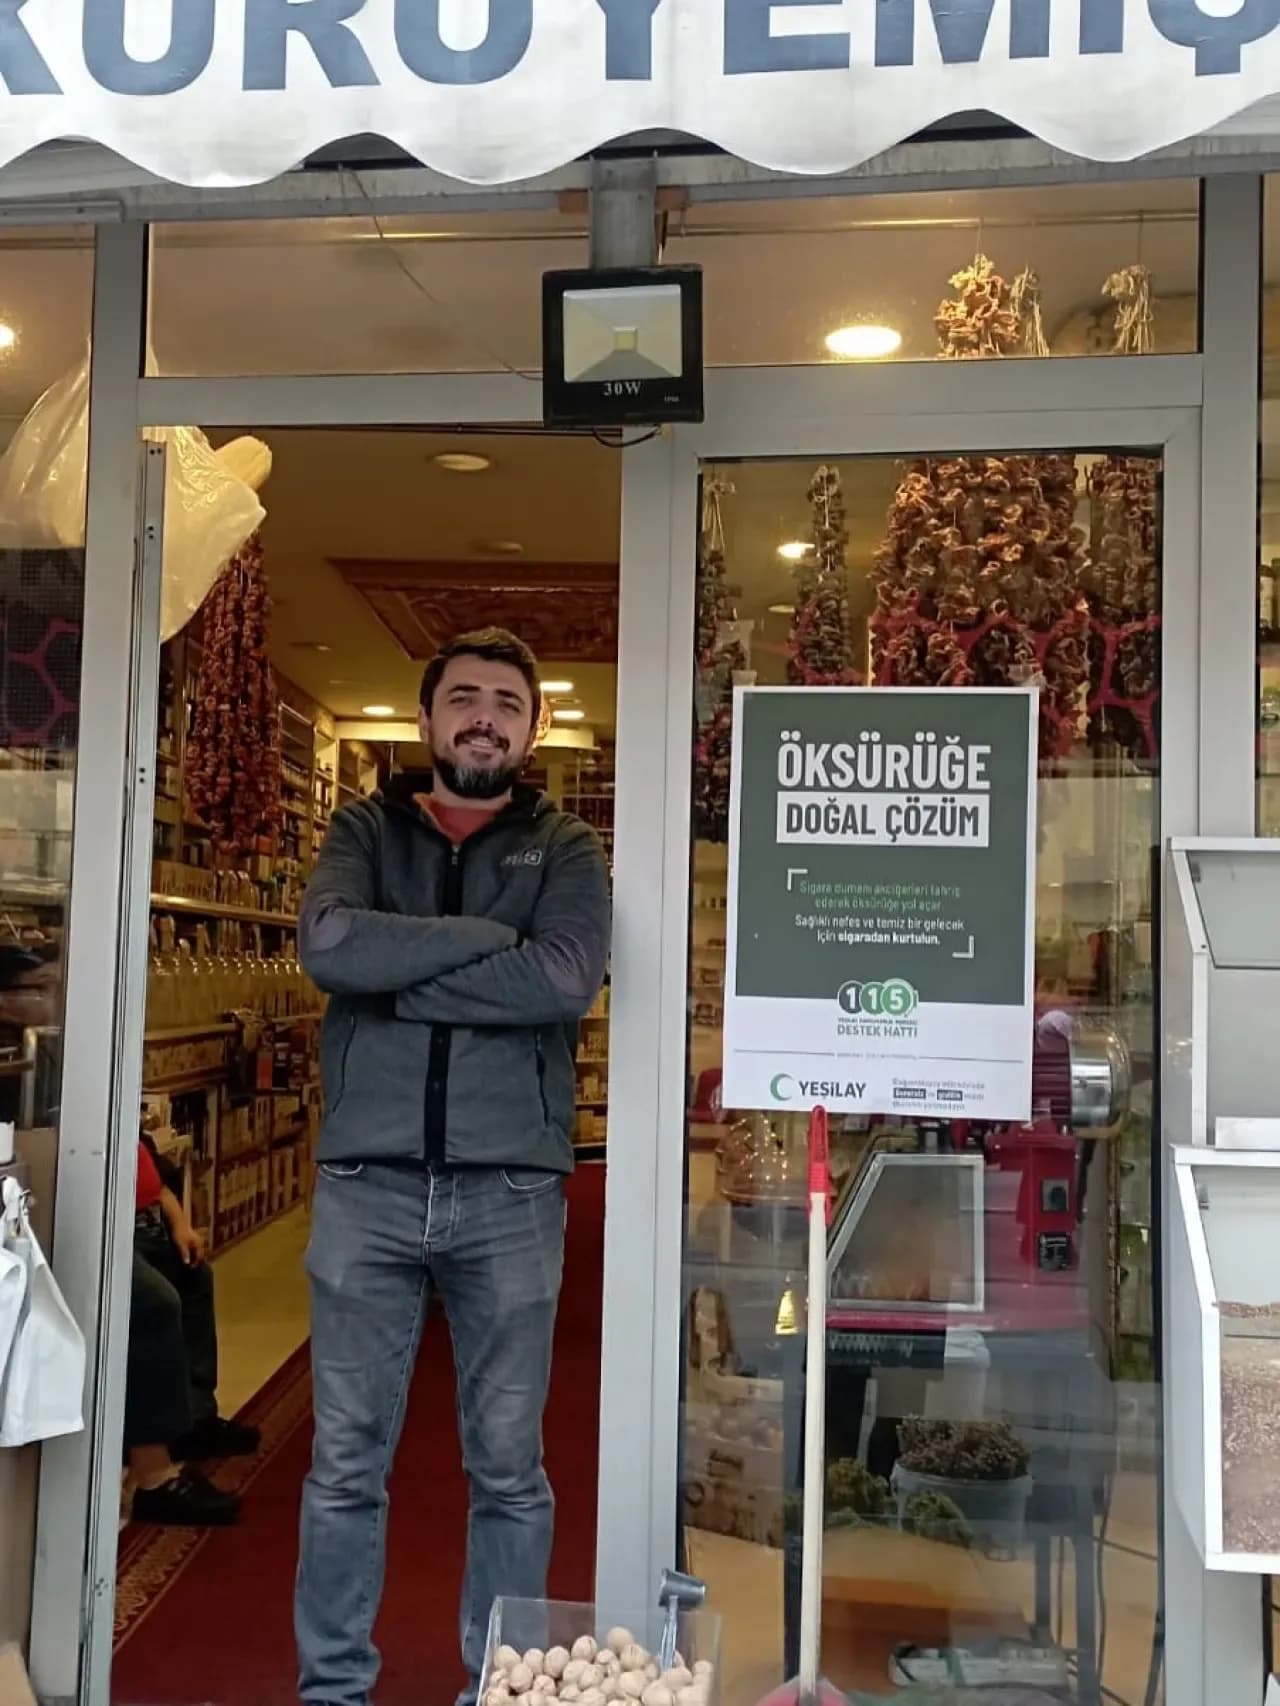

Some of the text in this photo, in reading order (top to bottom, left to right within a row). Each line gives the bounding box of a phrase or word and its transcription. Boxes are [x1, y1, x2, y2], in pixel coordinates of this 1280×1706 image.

[603, 381, 641, 396] 30W
[778, 730, 991, 790] ÖKSÜRÜĞE
[786, 796, 978, 842] DOĞAL ÇÖZÜM
[800, 881, 831, 895] Sigara
[900, 900, 917, 913] yol
[795, 914, 964, 932] Sağlıklı nefes ve temiz bir gelecek
[817, 931, 941, 945] için sigaradan kurtulun.
[844, 985, 907, 1012] 115
[837, 1024, 918, 1038] DESTEK HATTI
